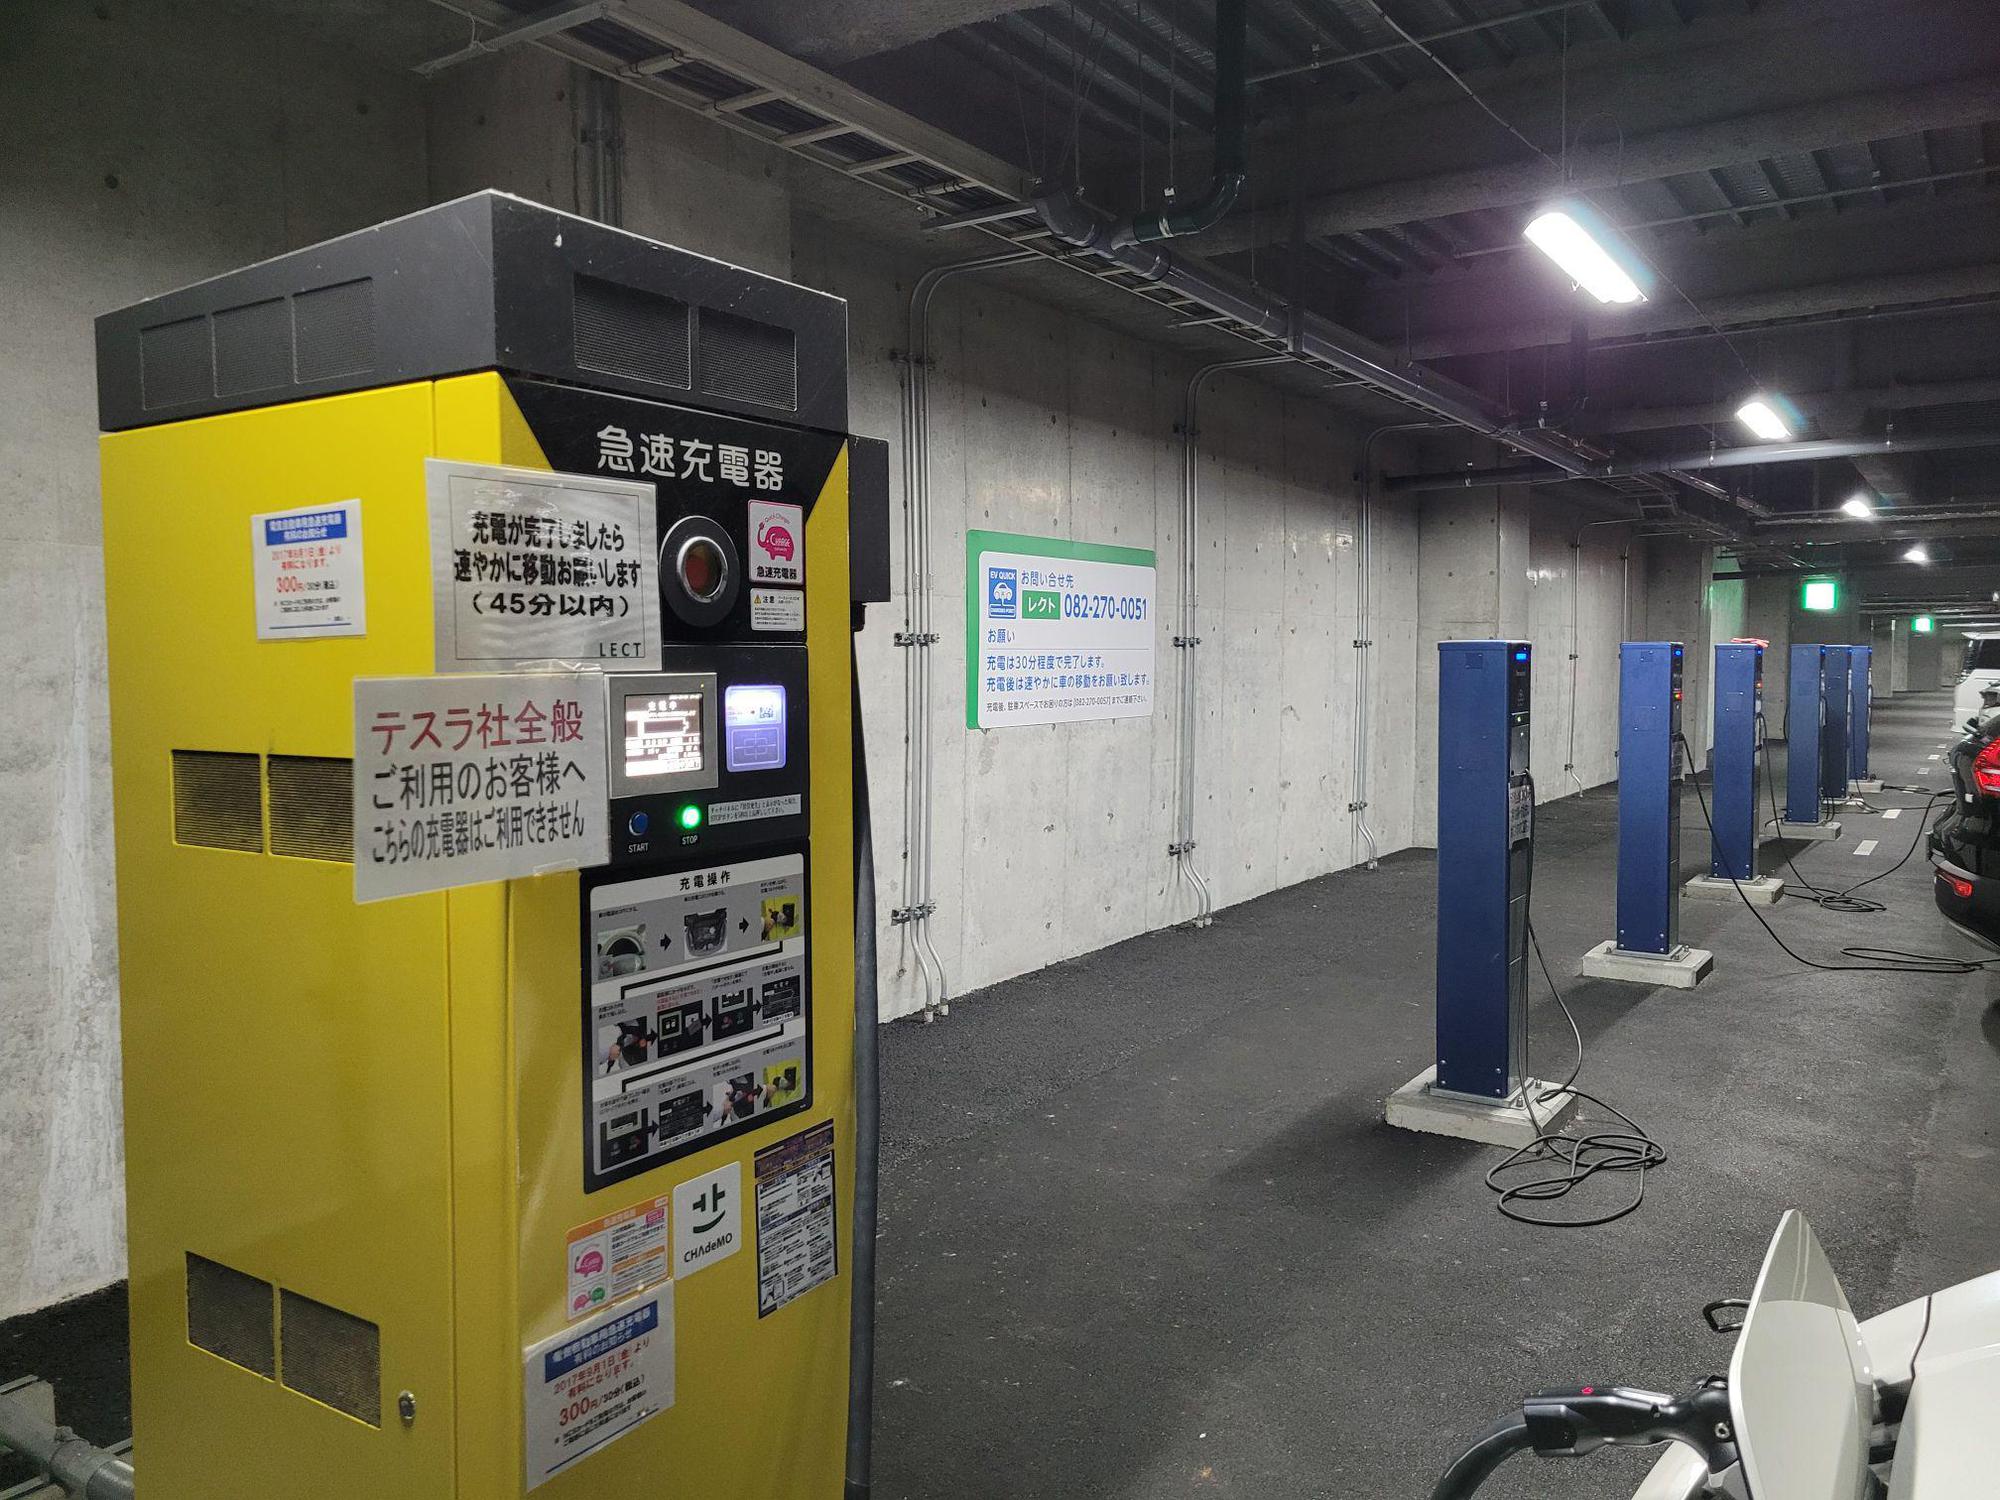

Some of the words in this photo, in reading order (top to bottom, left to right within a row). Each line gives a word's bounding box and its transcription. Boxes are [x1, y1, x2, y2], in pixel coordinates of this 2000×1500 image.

[597, 424, 783, 491] 急速充電器
[472, 511, 624, 551] 充電が完了しましたら
[454, 550, 641, 588] 速やかに移動お願いします
[757, 566, 797, 580] 急速充電器
[1021, 570, 1074, 588] お問い合せ先
[1028, 596, 1056, 613] レクト
[1064, 593, 1147, 620] 082-270-0051
[987, 629, 1015, 643] お願い
[599, 642, 641, 657] LECT
[986, 655, 1105, 671] 充電は30分程度で完了します。
[986, 673, 1150, 693] 充電後は速やかに車の移動をお願い致します。
[371, 699, 584, 755] テスラ社全般
[373, 751, 586, 809] ご利用のお客様へ
[373, 799, 584, 864] こちらの充電器はご利用できません
[682, 835, 698, 845] STOP
[628, 842, 648, 853] START
[679, 870, 732, 891] 充電操作
[683, 1233, 733, 1263] CHAdeMO
